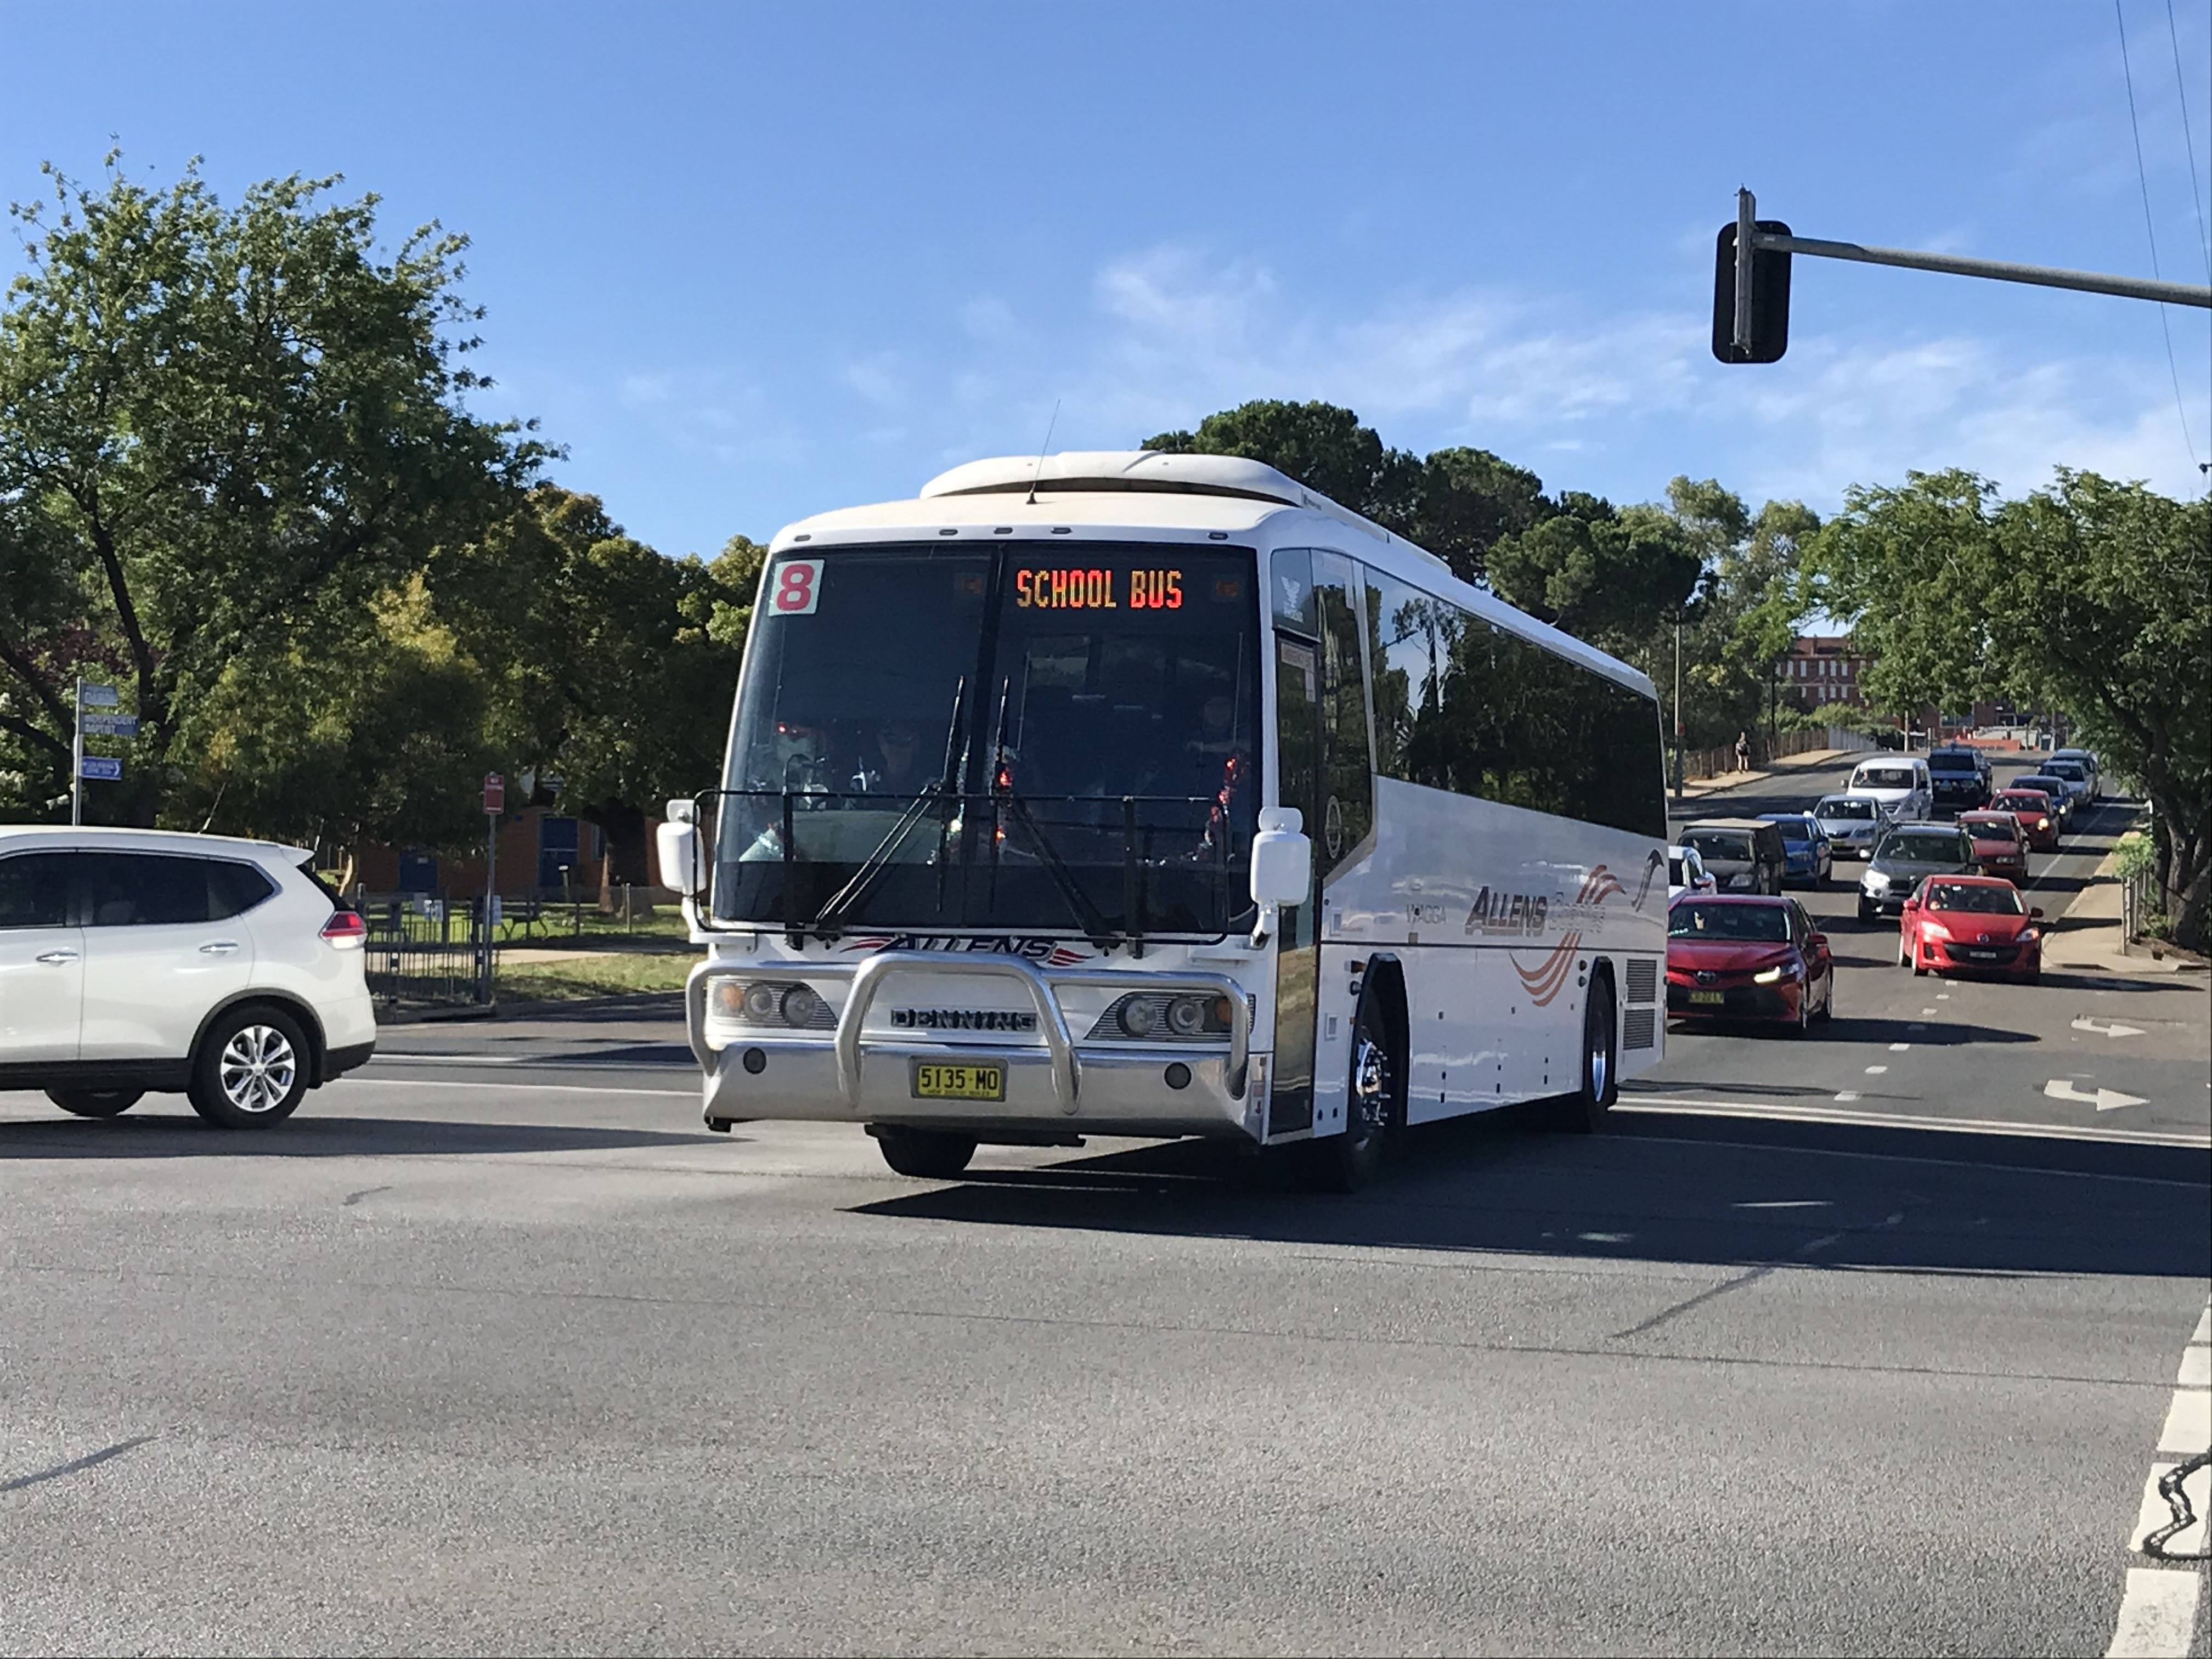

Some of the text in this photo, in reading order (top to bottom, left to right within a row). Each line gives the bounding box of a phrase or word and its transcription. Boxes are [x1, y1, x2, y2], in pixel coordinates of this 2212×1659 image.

[777, 563, 814, 611] 8
[1017, 569, 1182, 608] SCHOOL BUS
[1465, 885, 1549, 936] ALLENS
[891, 1009, 1037, 1032] DENNING
[922, 1068, 966, 1089] 5135
